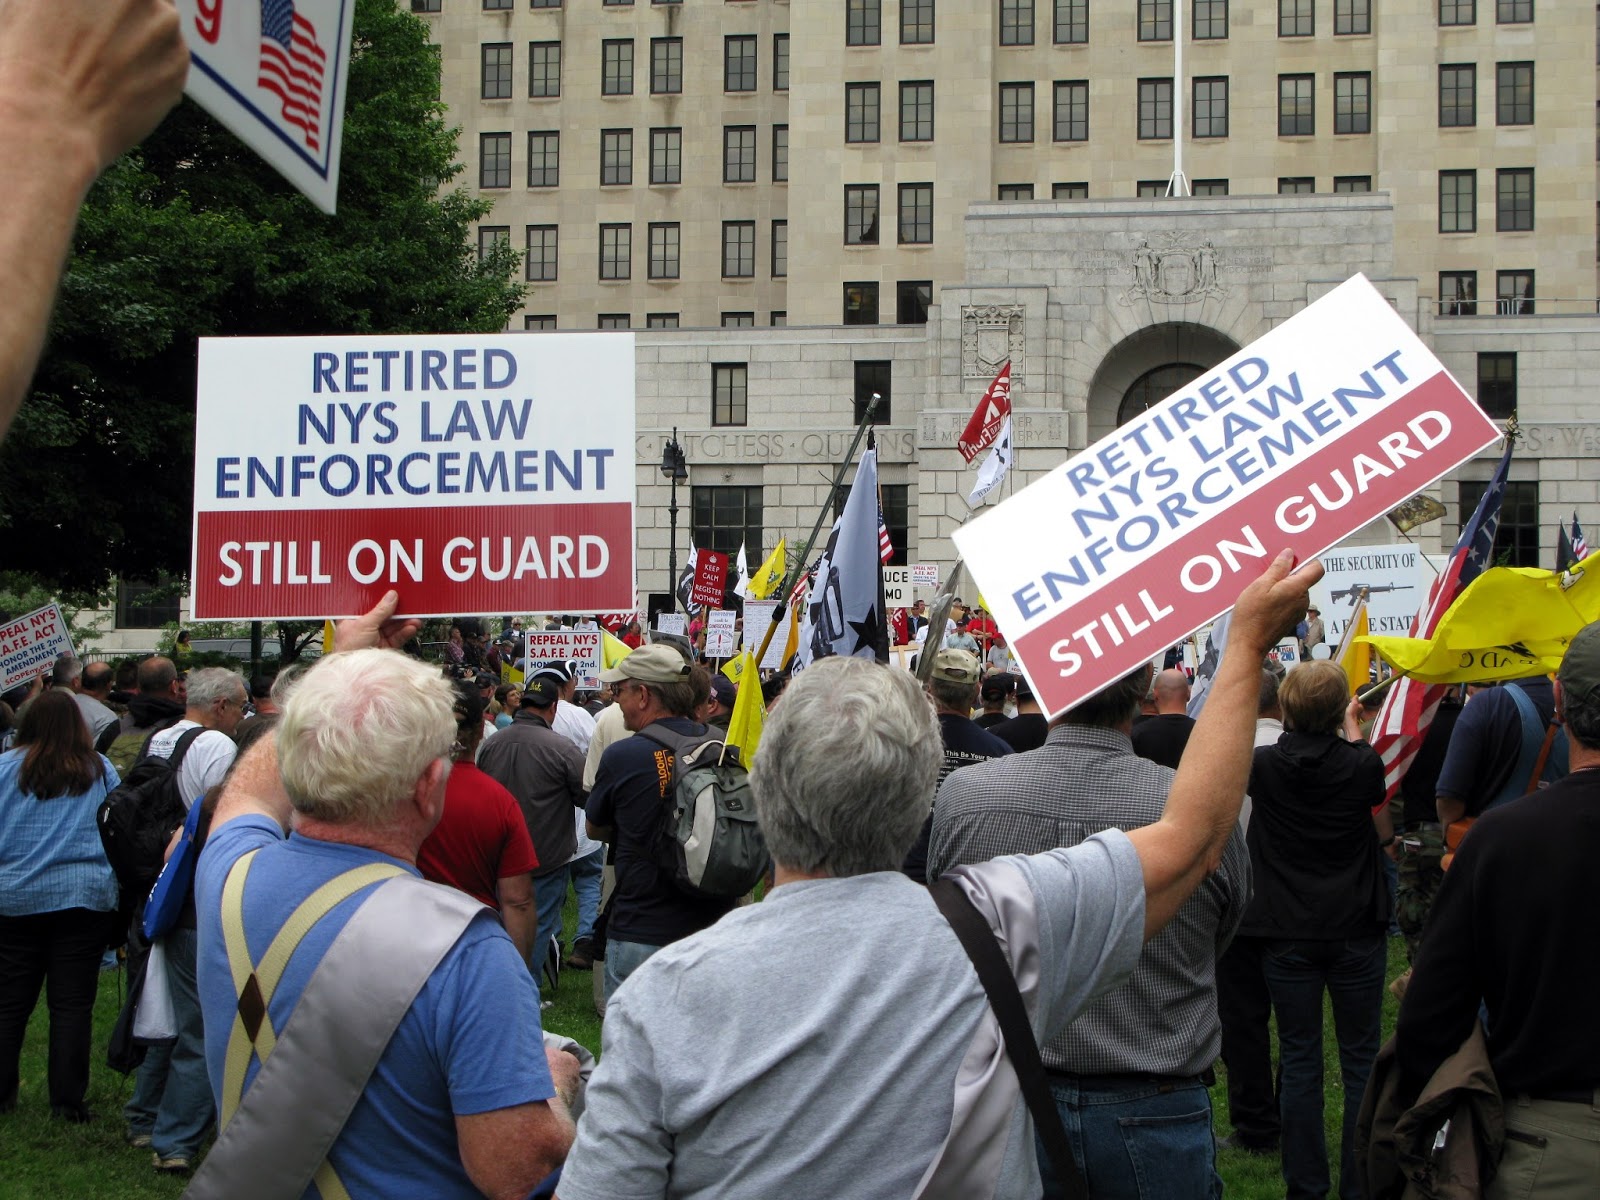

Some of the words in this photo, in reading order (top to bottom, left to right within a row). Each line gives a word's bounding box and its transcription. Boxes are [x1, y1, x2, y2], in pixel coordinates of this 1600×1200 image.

[313, 348, 518, 394] RETIRED
[298, 400, 399, 446] NYS
[420, 398, 533, 443] LAW
[952, 416, 1032, 428] REAER
[1066, 356, 1271, 498] RETIRED
[941, 430, 1043, 442] MOERY
[659, 435, 784, 458] DTCHESS
[802, 434, 915, 457] QUENS
[1071, 456, 1179, 539] NYS
[1189, 371, 1305, 464] LAW
[216, 449, 614, 499] ENFORCEMENT
[1011, 349, 1410, 622] ENFORCEMENT
[1049, 588, 1174, 678] STILL
[1179, 524, 1268, 594] ON
[1274, 409, 1453, 535] GUARD
[218, 540, 331, 586] STILL
[347, 538, 424, 584] ON
[442, 534, 610, 582] GUARD
[704, 564, 720, 572] KEEP
[1324, 557, 1346, 572] THE
[1347, 554, 1399, 571] SECURITY
[1401, 553, 1416, 568] OF
[702, 573, 719, 582] CALM
[884, 571, 909, 583] UCE
[693, 593, 720, 605] NOTHING
[695, 583, 721, 596] REGISTER
[885, 588, 902, 600] MO
[30, 609, 56, 628] NY'S
[1331, 620, 1339, 634] A
[1342, 617, 1377, 633] FE
[1379, 615, 1416, 632] STAT
[35, 623, 56, 641] ACT
[530, 635, 569, 645] REPEAL
[573, 634, 598, 645] NY'S
[30, 642, 47, 655] THE
[47, 635, 65, 647] 2nd.
[530, 648, 568, 658] S.A.F.E.
[571, 647, 593, 658] ACT
[6, 646, 58, 676] AMENDMENT
[530, 661, 549, 669] HON
[580, 660, 598, 668] 2nd.
[5, 661, 54, 686] SCOPEny.org
[946, 750, 959, 758] This
[970, 752, 985, 760] Your
